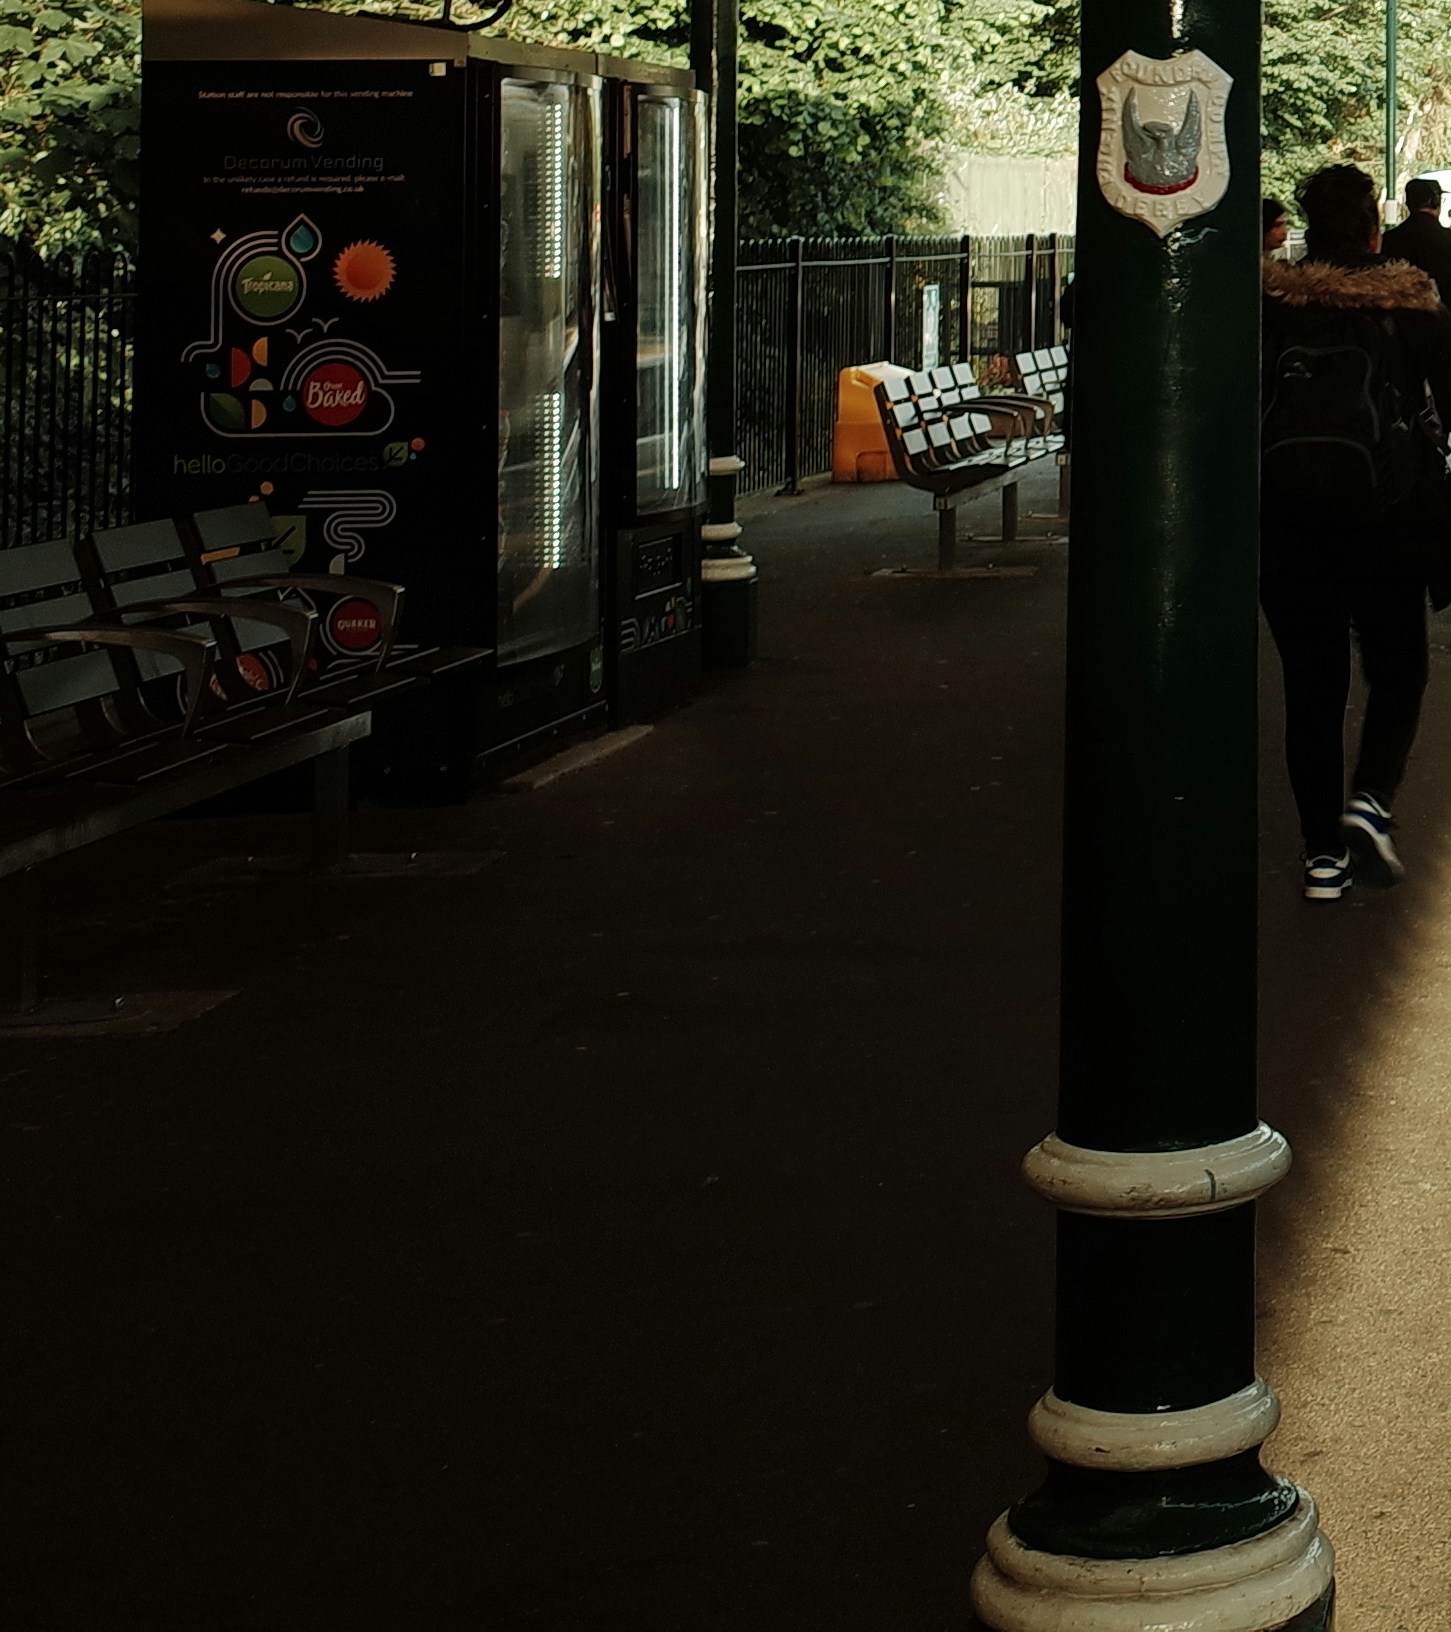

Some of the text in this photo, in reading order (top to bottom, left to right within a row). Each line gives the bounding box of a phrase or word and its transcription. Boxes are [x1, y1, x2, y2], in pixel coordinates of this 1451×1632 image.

[223, 152, 385, 172] Decorum Vending
[240, 272, 295, 295] Tropicana
[307, 380, 367, 409] Baked
[336, 617, 378, 632] QUAKER
